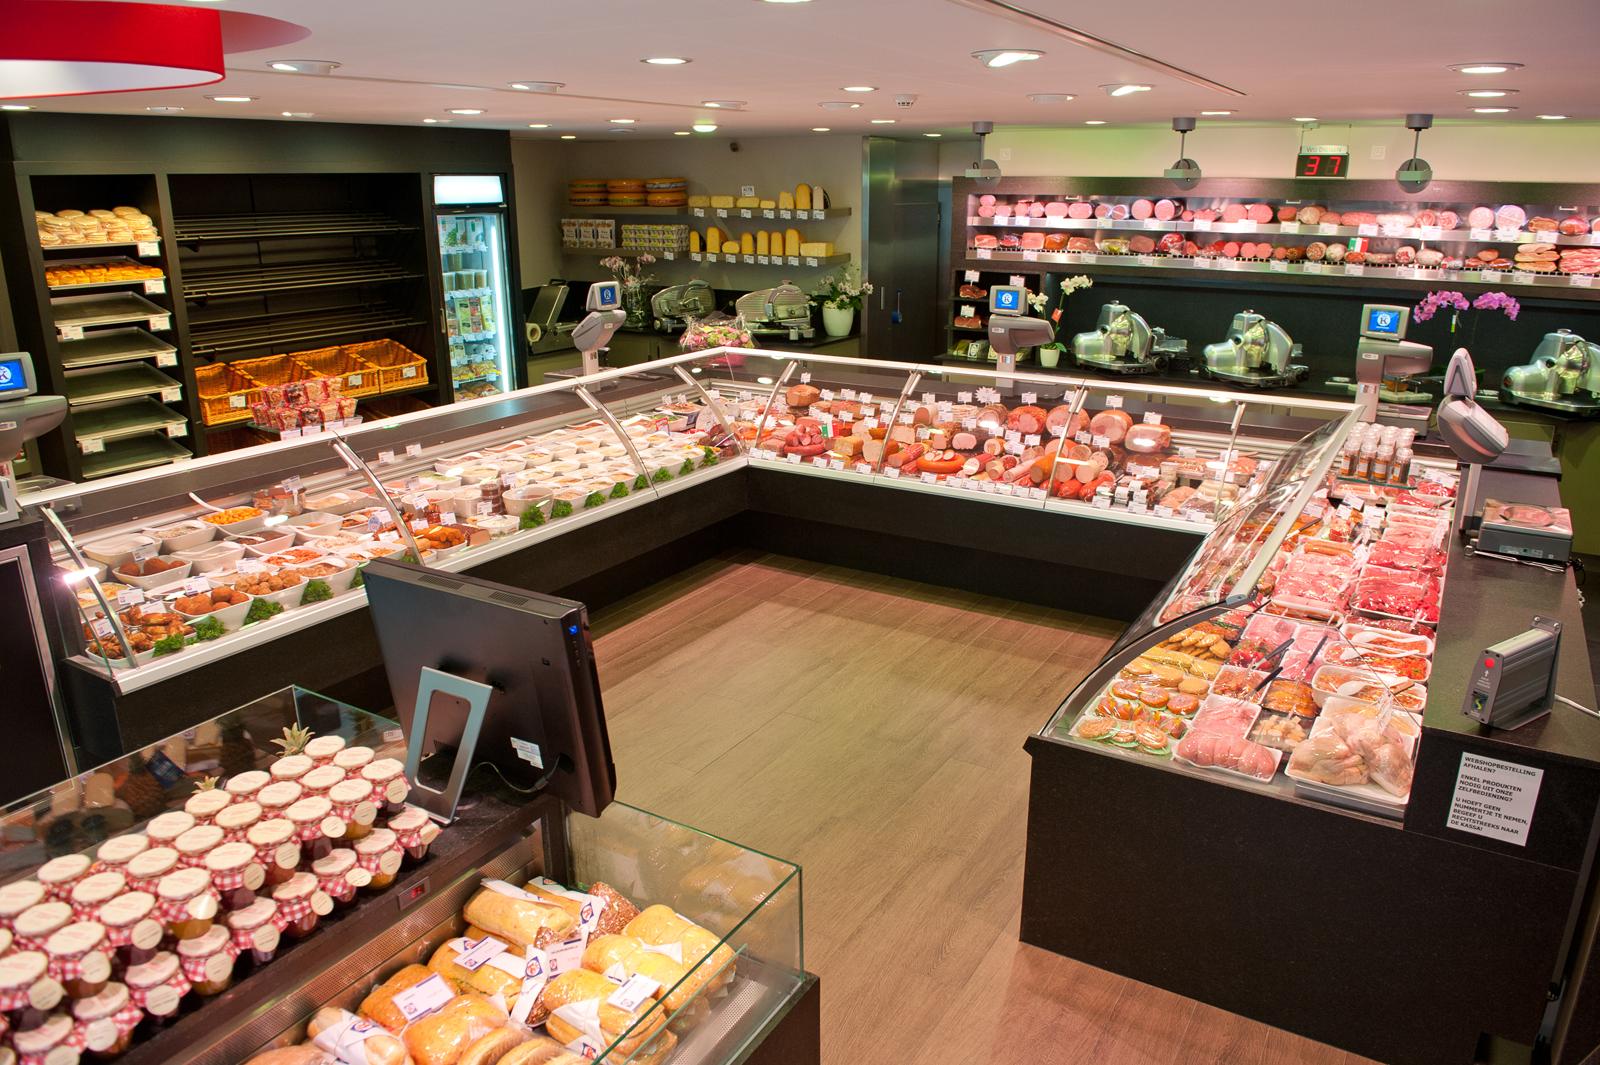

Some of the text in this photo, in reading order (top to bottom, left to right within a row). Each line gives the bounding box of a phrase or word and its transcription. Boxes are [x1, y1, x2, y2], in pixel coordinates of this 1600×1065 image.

[1304, 156, 1342, 176] 37
[1464, 757, 1536, 776] WEBSHOPBESTELLING
[1464, 763, 1496, 774] AFHALEN?
[1460, 780, 1480, 789] NODIG
[1461, 774, 1522, 792] ENKEL PRODUKTEN
[1458, 786, 1513, 802] ZELFBEDIENING?
[1455, 803, 1492, 816] NUMMERTJE
[1462, 798, 1482, 807] HOEFT
[1453, 809, 1476, 817] BEGEEF
[1452, 814, 1519, 834] RECHTSTREEKS NAAR
